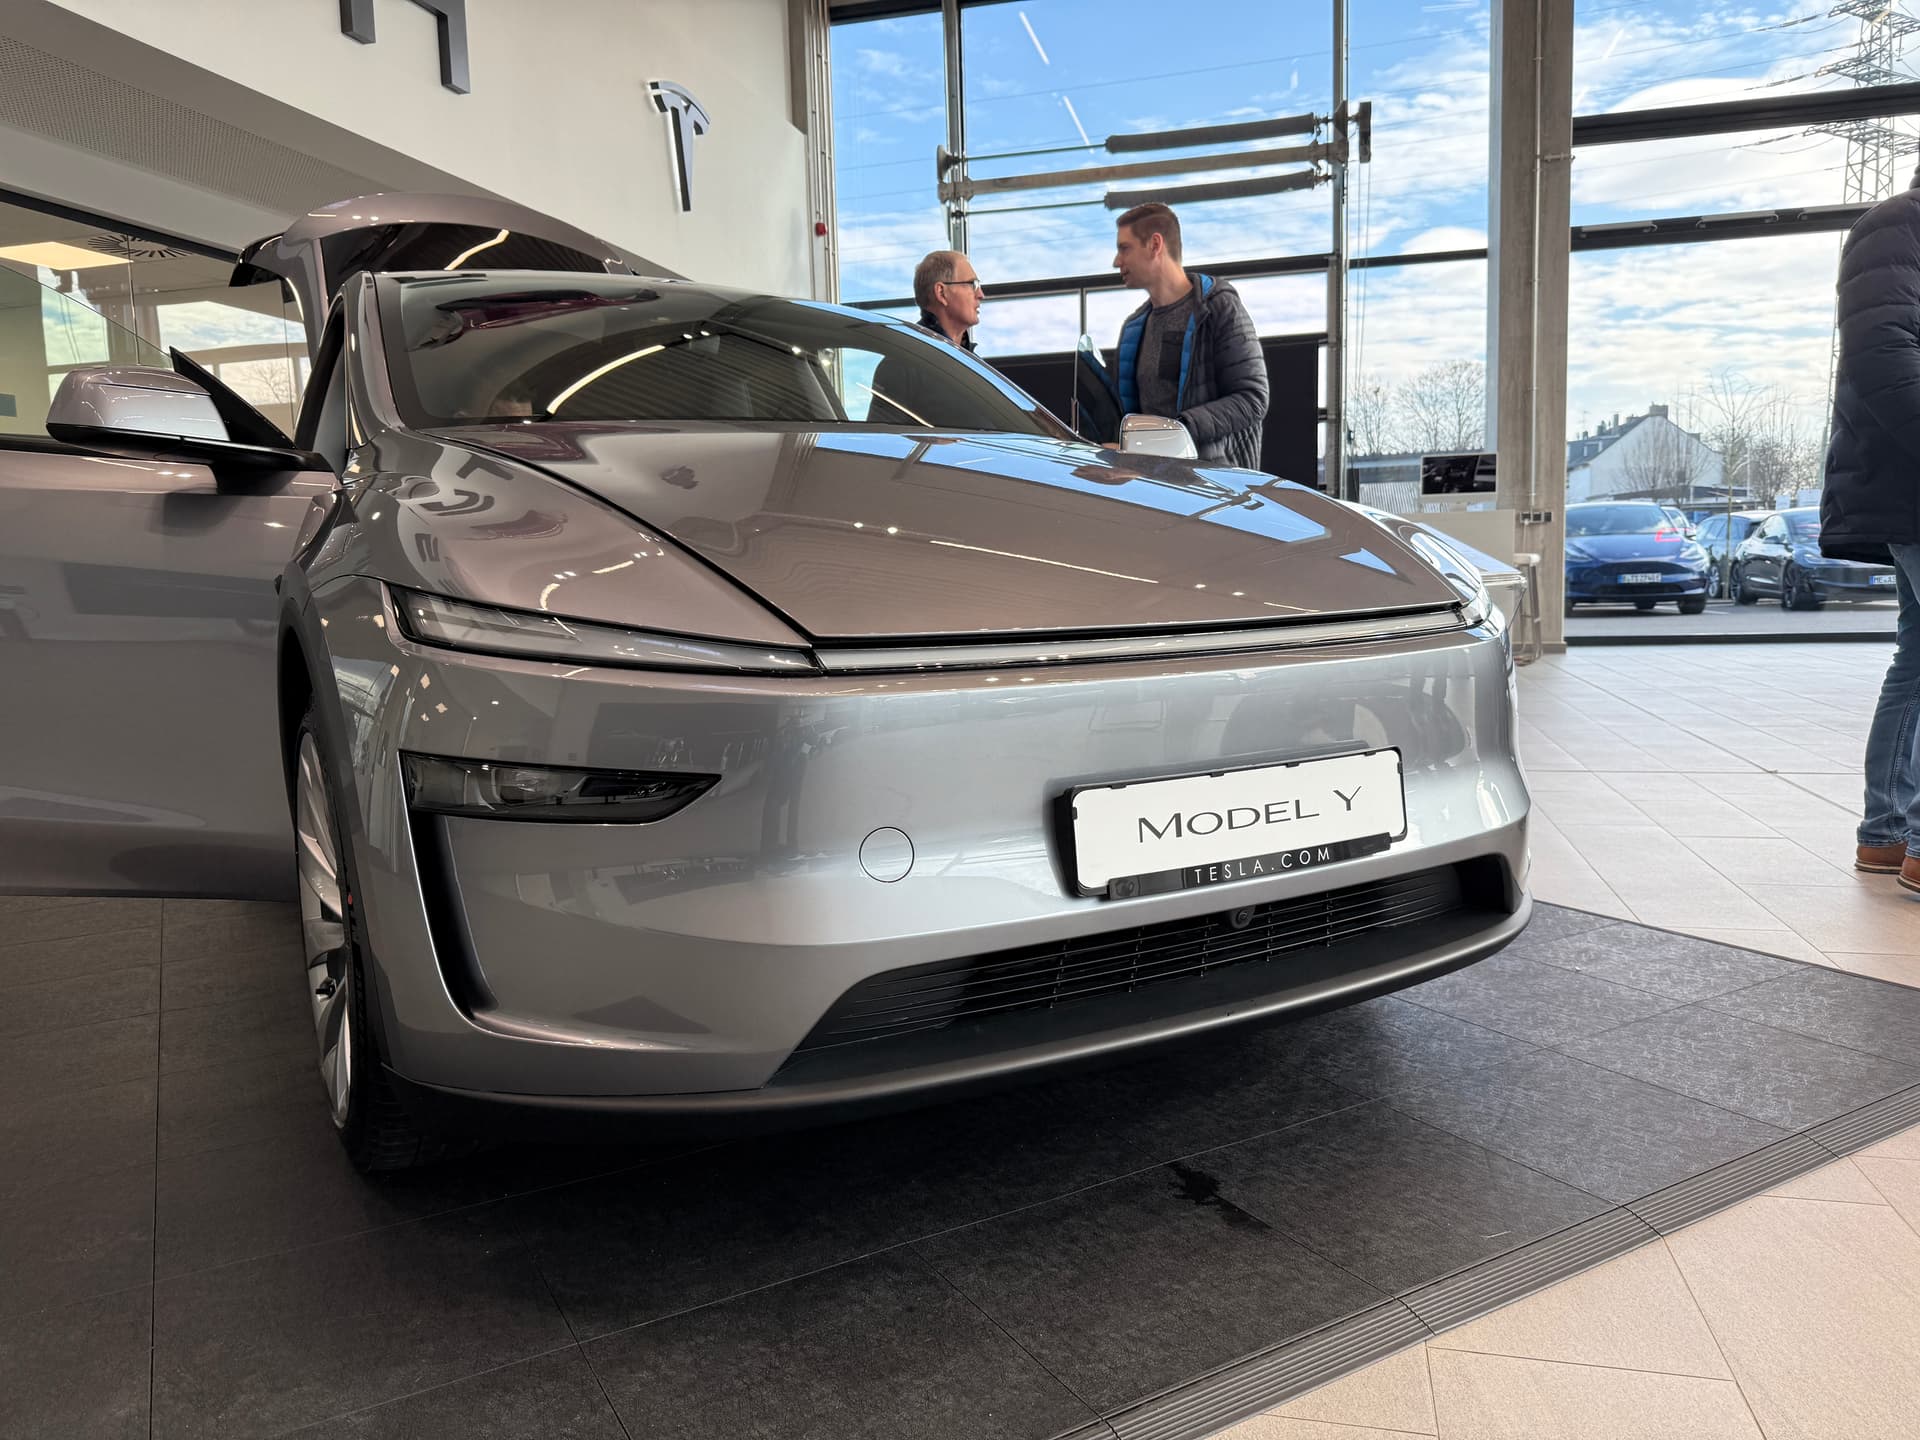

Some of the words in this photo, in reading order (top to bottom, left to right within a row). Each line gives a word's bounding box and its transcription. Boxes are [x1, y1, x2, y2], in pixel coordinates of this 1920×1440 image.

[1138, 799, 1320, 843] MODEL
[1333, 785, 1362, 811] Y
[1194, 847, 1330, 884] TESLA.COM
